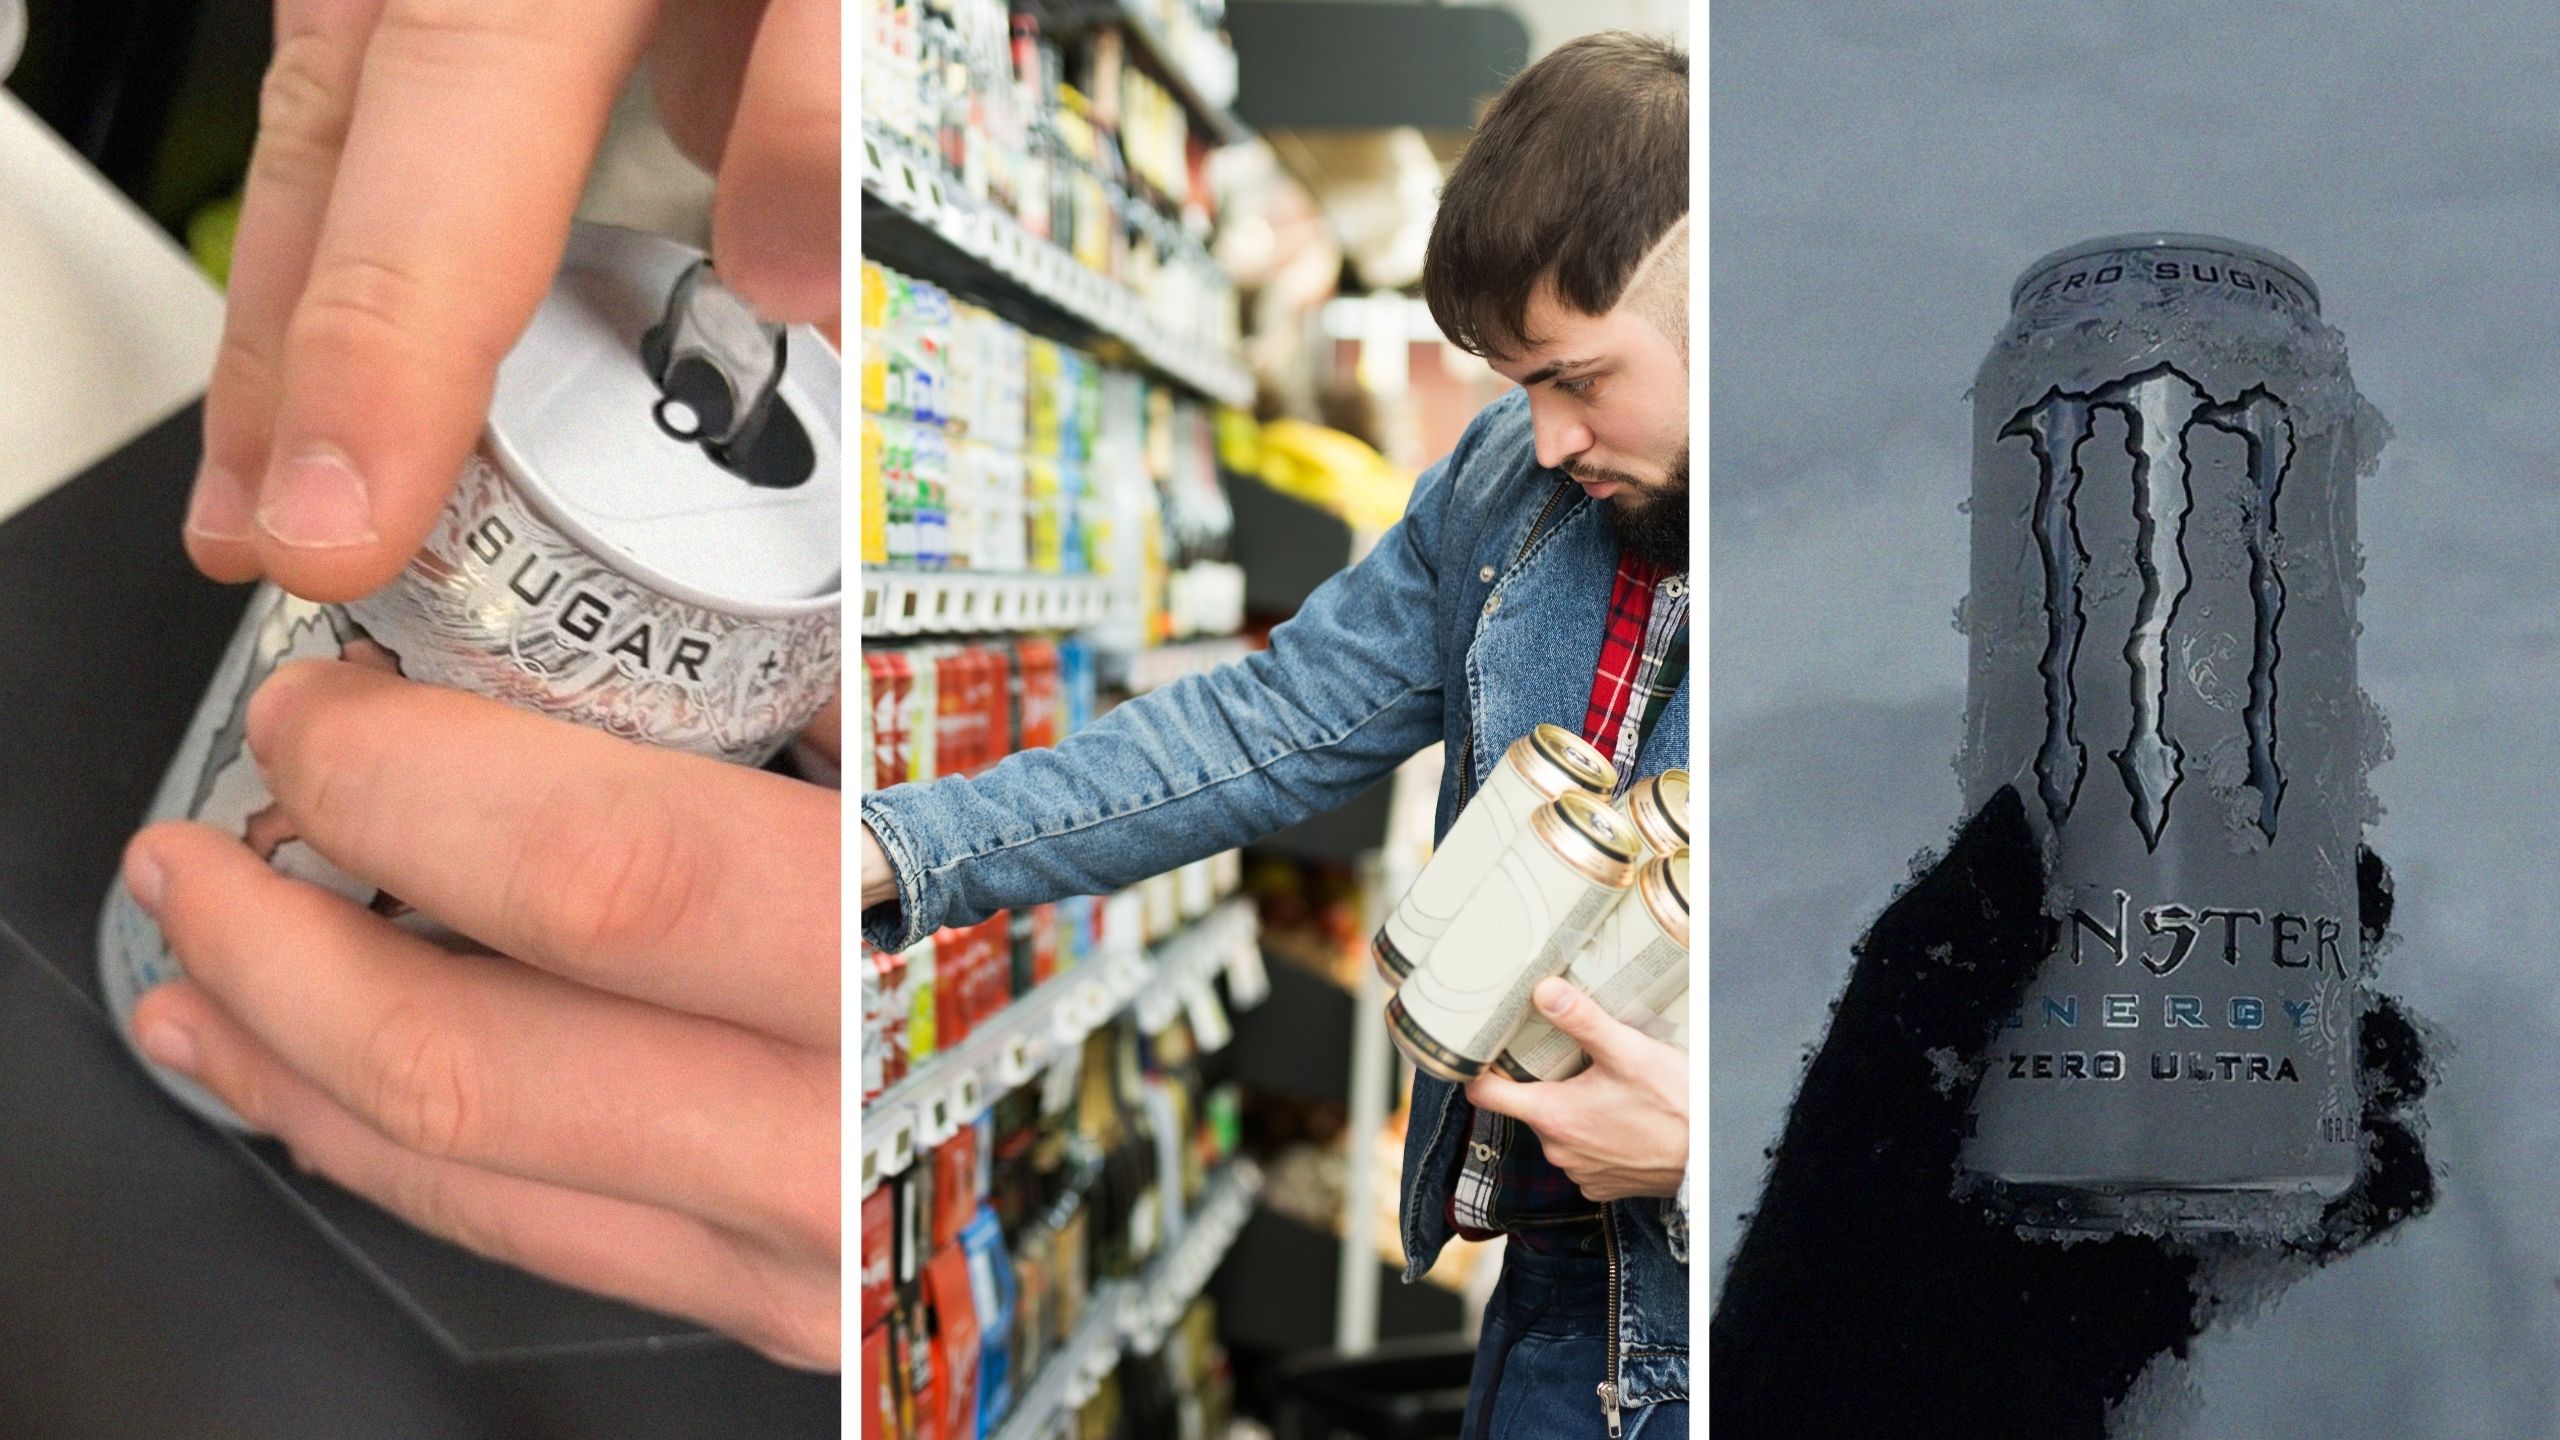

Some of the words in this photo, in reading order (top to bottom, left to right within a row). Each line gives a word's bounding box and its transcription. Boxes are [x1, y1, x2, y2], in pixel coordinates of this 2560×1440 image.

[465, 514, 713, 683] SUGAR
[2068, 889, 2349, 982] NSTER
[2007, 1051, 2126, 1081] ZERO
